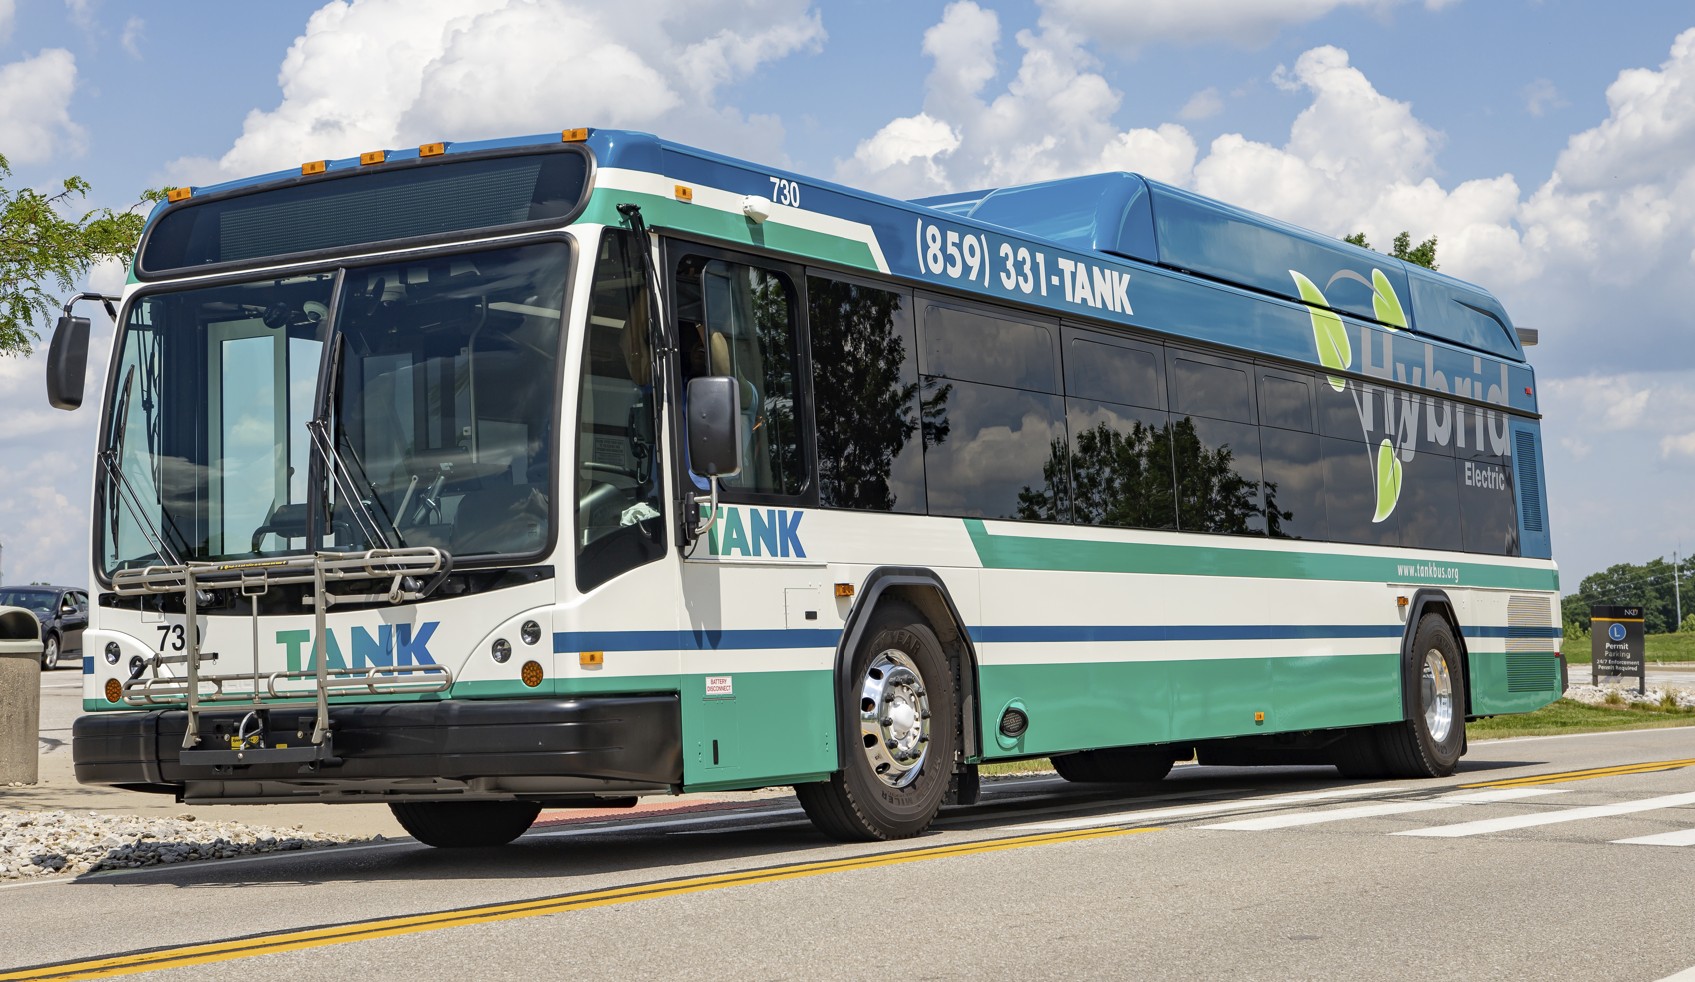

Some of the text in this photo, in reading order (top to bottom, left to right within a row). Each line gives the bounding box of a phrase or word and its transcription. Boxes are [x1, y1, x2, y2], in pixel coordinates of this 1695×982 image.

[769, 176, 800, 208] 730
[916, 217, 1134, 316] (859) 331-TANK
[1360, 326, 1511, 463] Hybrid
[1464, 461, 1505, 491] Electric
[700, 505, 807, 558] TANK
[1397, 561, 1459, 583] www.tankbus.org
[156, 623, 200, 652] 73
[1614, 627, 1620, 637] L
[275, 621, 441, 681] TANK
[1604, 651, 1631, 659] Parking
